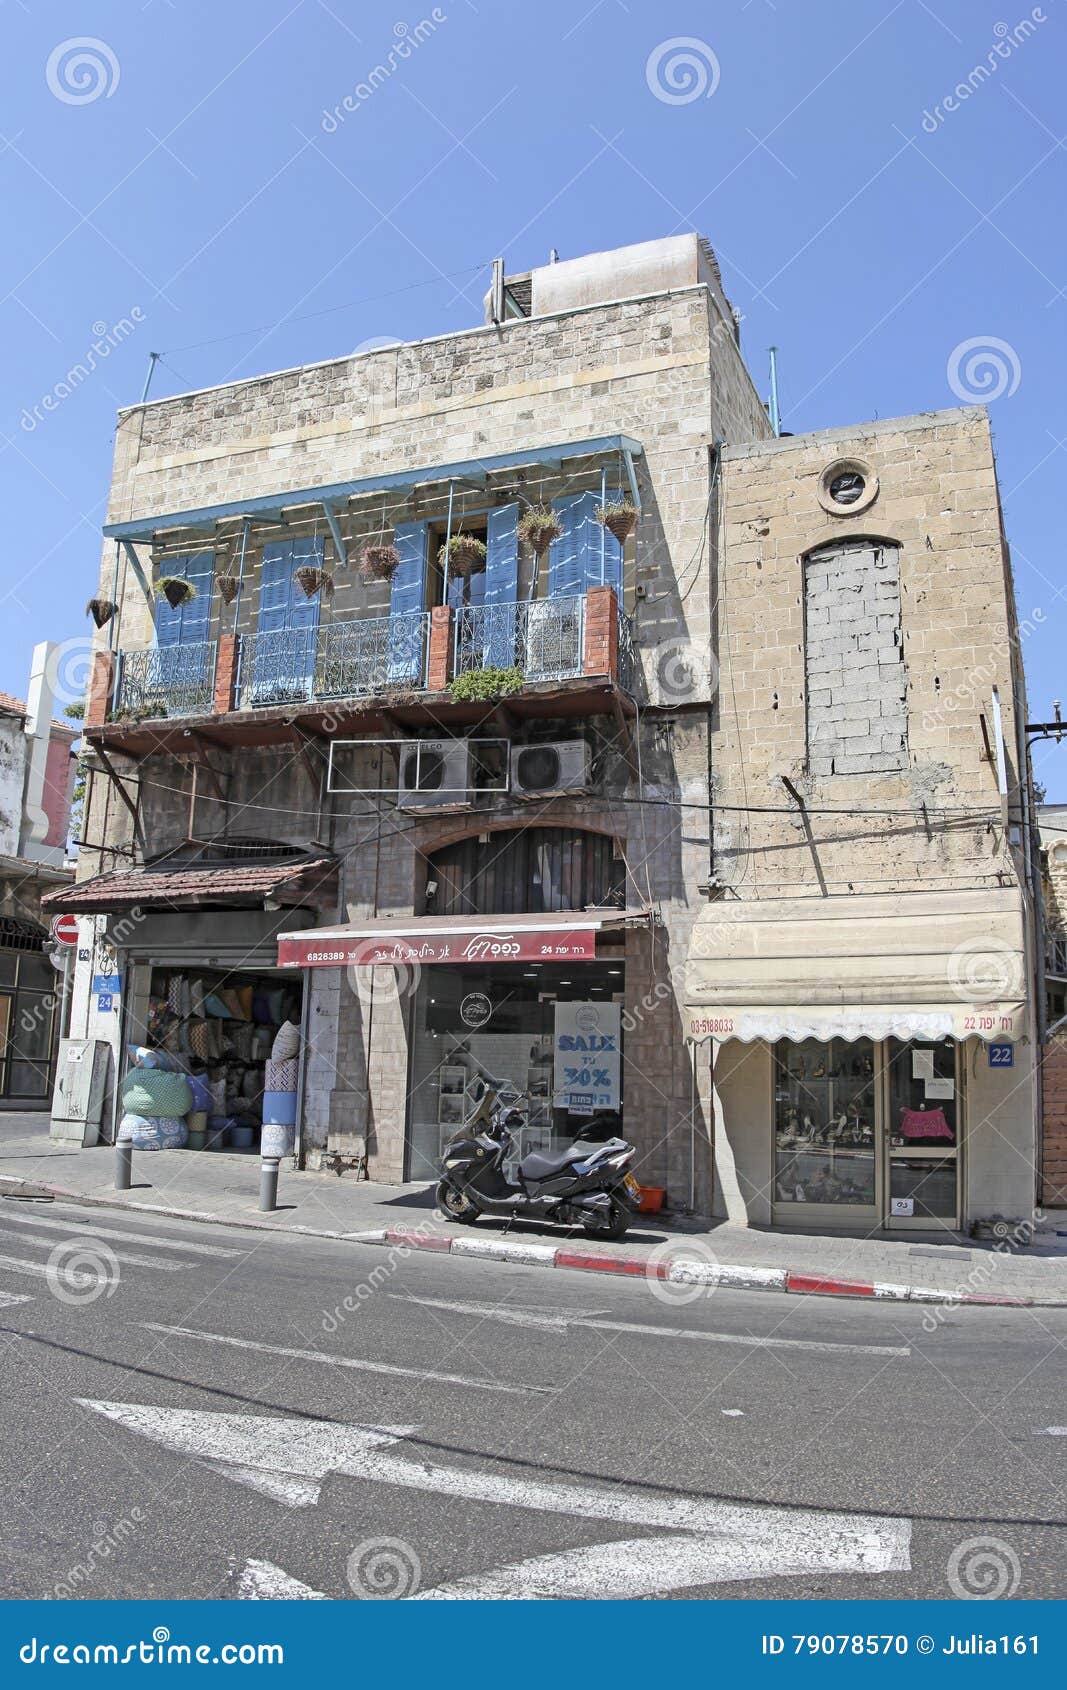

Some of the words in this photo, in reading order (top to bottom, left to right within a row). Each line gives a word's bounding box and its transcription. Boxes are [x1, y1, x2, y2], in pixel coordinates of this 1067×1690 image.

[81, 949, 88, 958] 24
[541, 945, 552, 954] 24
[99, 996, 111, 1008] 24
[964, 1017, 976, 1030] 22
[979, 1016, 995, 1030] יפת
[991, 1048, 1012, 1062] 22
